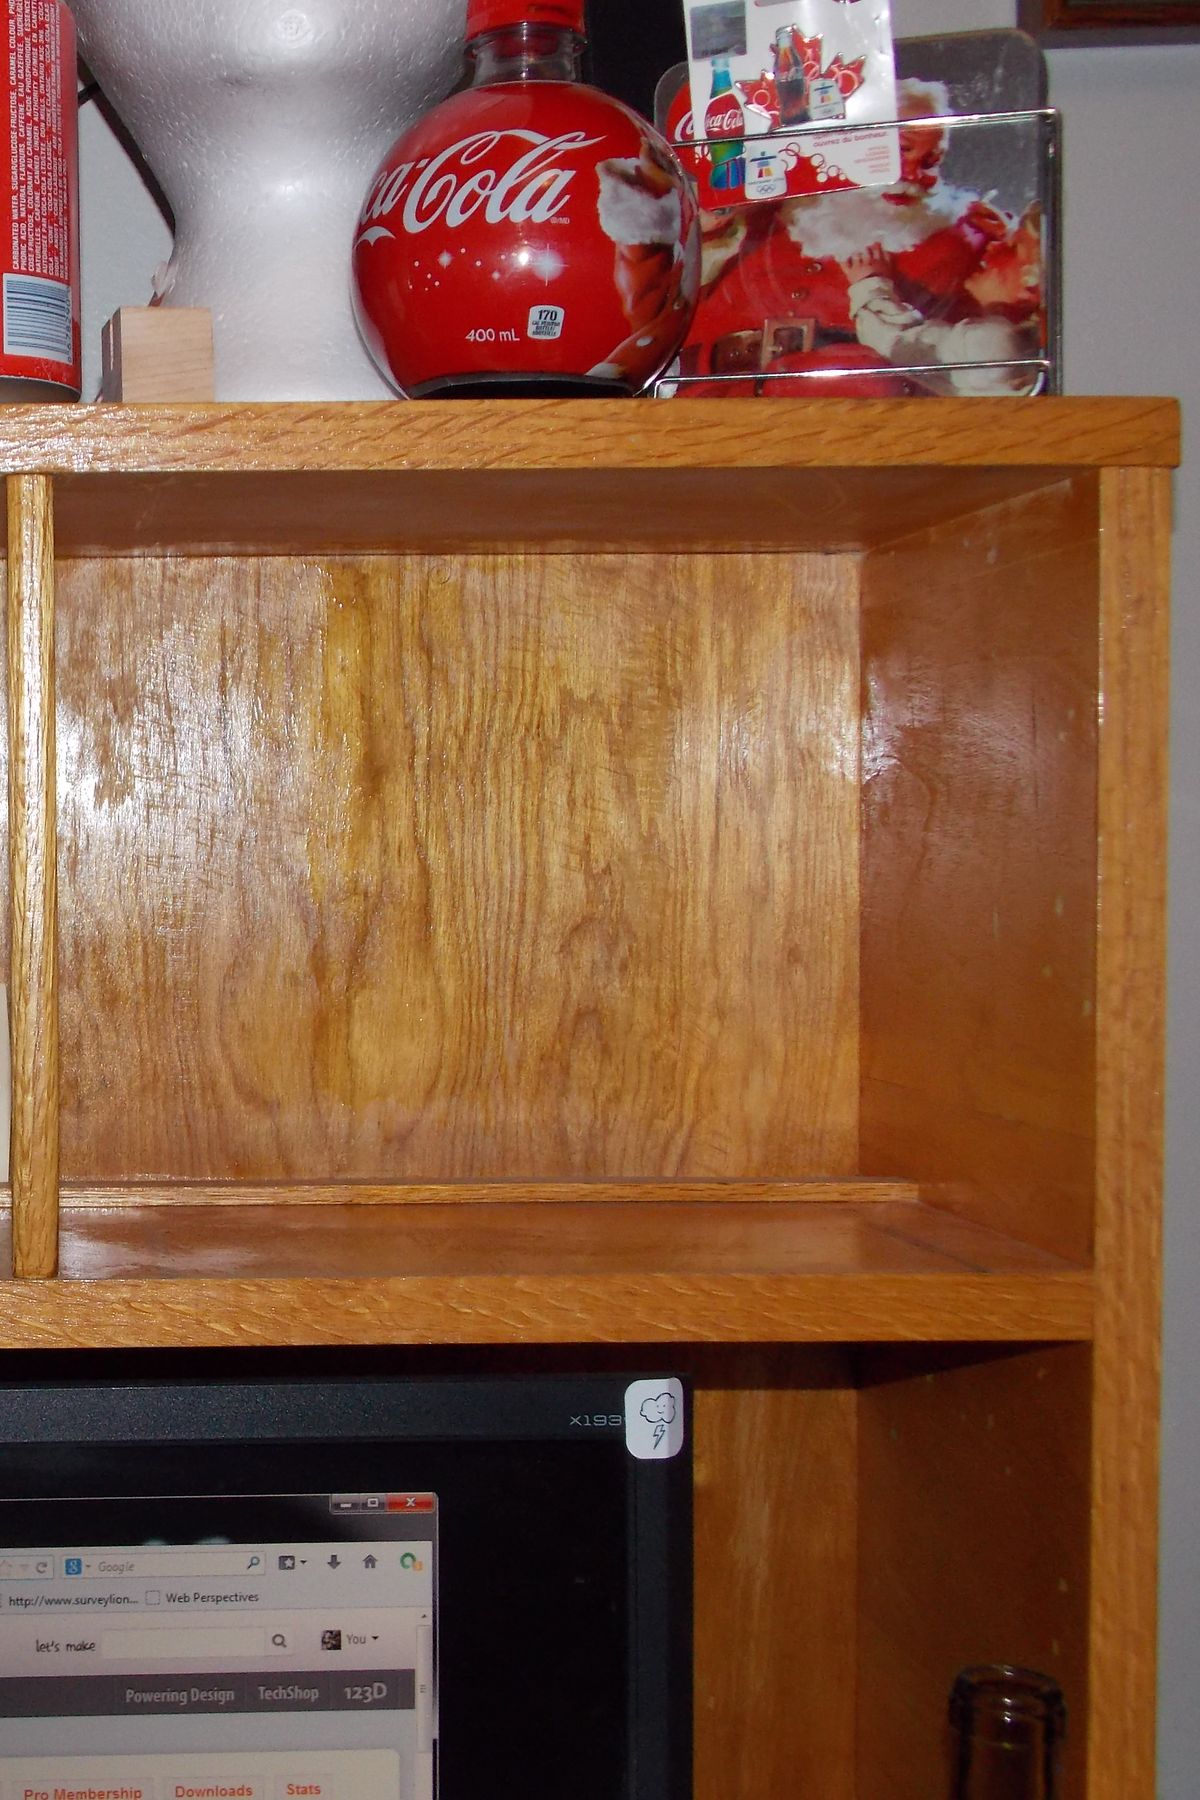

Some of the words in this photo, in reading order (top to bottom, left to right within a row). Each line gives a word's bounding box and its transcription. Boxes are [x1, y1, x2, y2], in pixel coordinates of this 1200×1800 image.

[9, 52, 17, 85] CARAMEL
[19, 184, 27, 217] NATURAL
[538, 309, 558, 321] 170
[465, 329, 496, 342] 400
[499, 330, 521, 342] mL
[569, 1414, 626, 1426] X193
[98, 1561, 135, 1575] Google
[166, 1592, 190, 1604] Web
[193, 1590, 259, 1605] Perspectives
[35, 1638, 60, 1653] let's
[66, 1640, 96, 1653] make
[346, 1632, 367, 1646] You
[125, 1687, 187, 1705] Powering
[191, 1686, 235, 1703] Design
[258, 1684, 319, 1701] TechShop
[344, 1682, 388, 1702] 123D
[24, 1789, 49, 1800] Pro
[54, 1787, 143, 1800] Membership
[175, 1785, 253, 1798] Downloads
[287, 1783, 321, 1796] Stats
